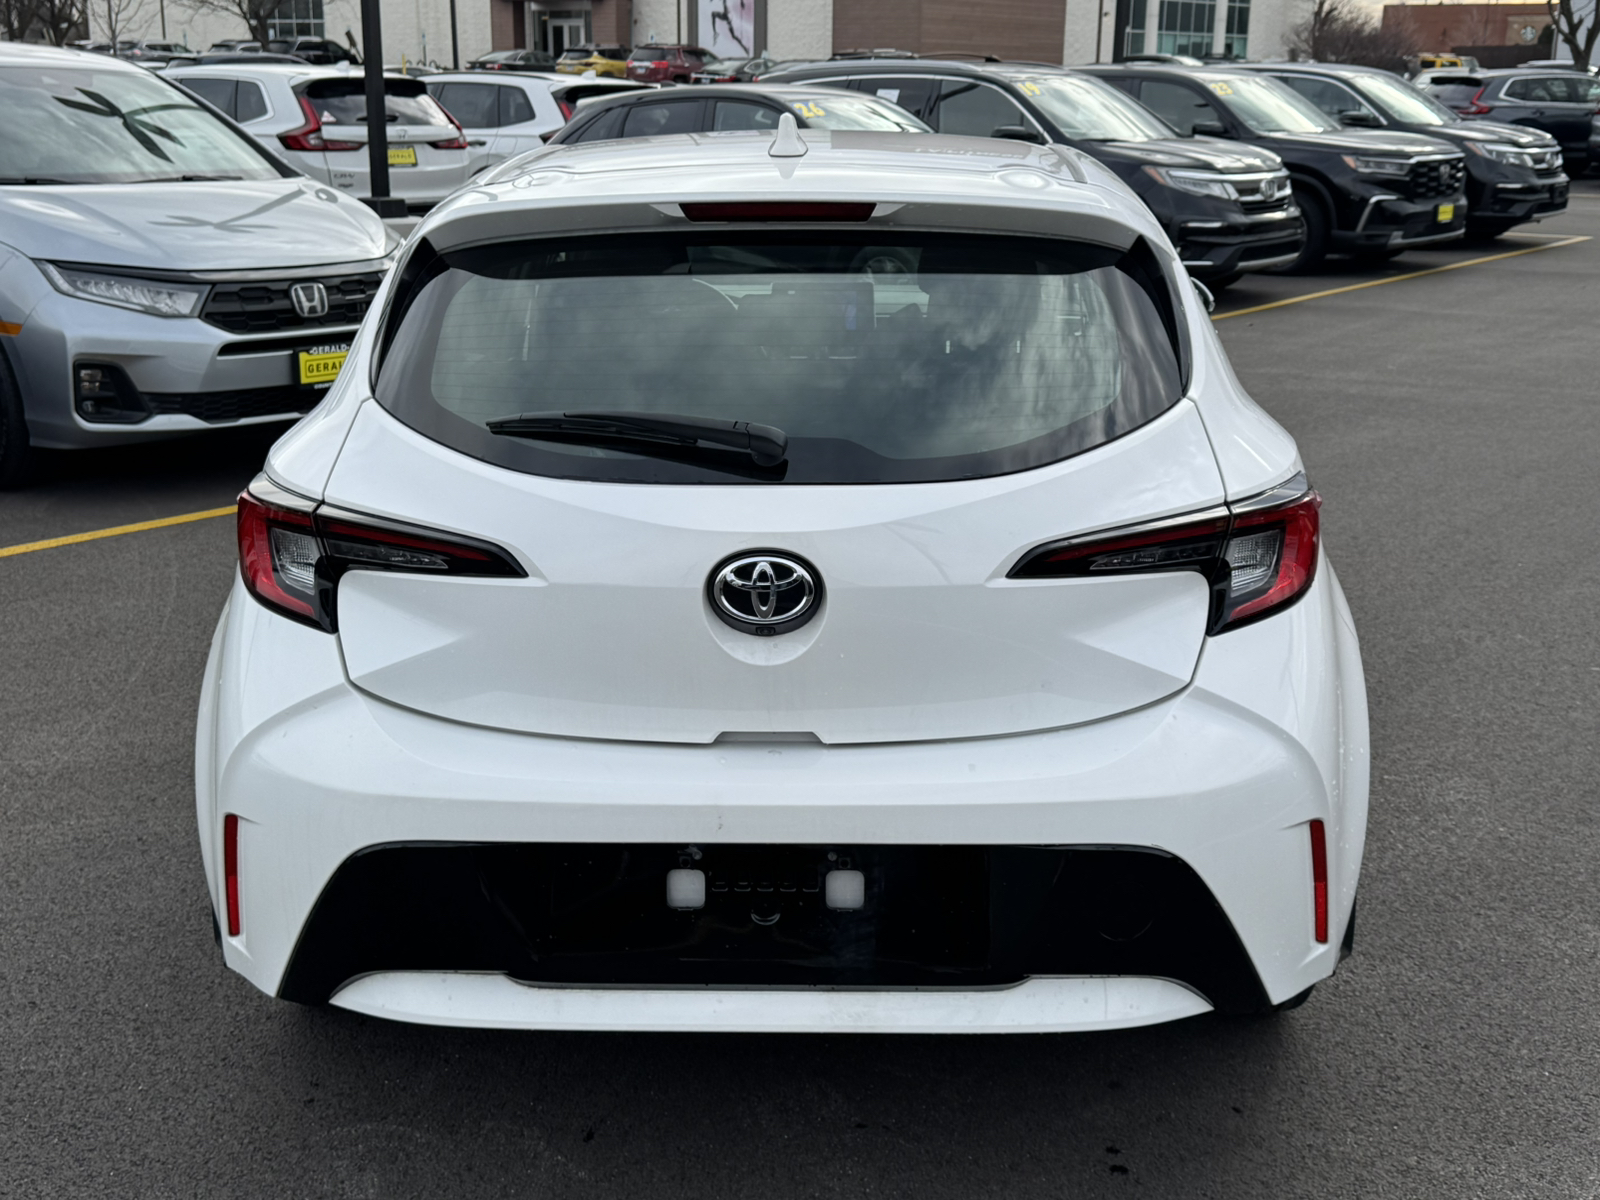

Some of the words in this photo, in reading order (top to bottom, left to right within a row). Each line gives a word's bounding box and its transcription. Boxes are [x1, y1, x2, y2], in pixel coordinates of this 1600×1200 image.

[1017, 82, 1041, 97] 19
[1211, 82, 1234, 96] 23
[793, 102, 826, 118] 26
